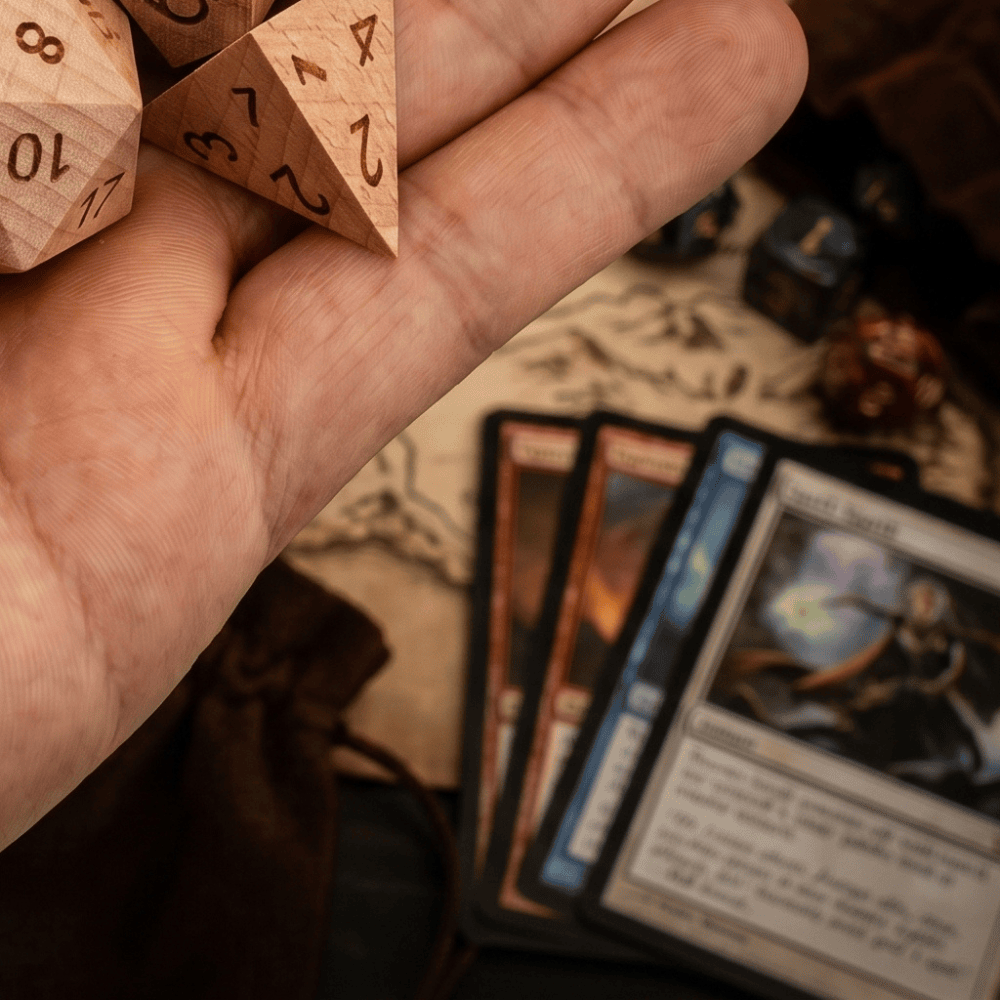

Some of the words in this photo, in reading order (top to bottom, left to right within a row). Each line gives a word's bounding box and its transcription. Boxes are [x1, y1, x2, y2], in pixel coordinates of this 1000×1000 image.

[15, 21, 65, 65] 8
[350, 13, 378, 67] 4
[7, 132, 70, 183] 10
[183, 131, 238, 162] 3
[350, 113, 383, 188] 2
[269, 164, 331, 216] 2
